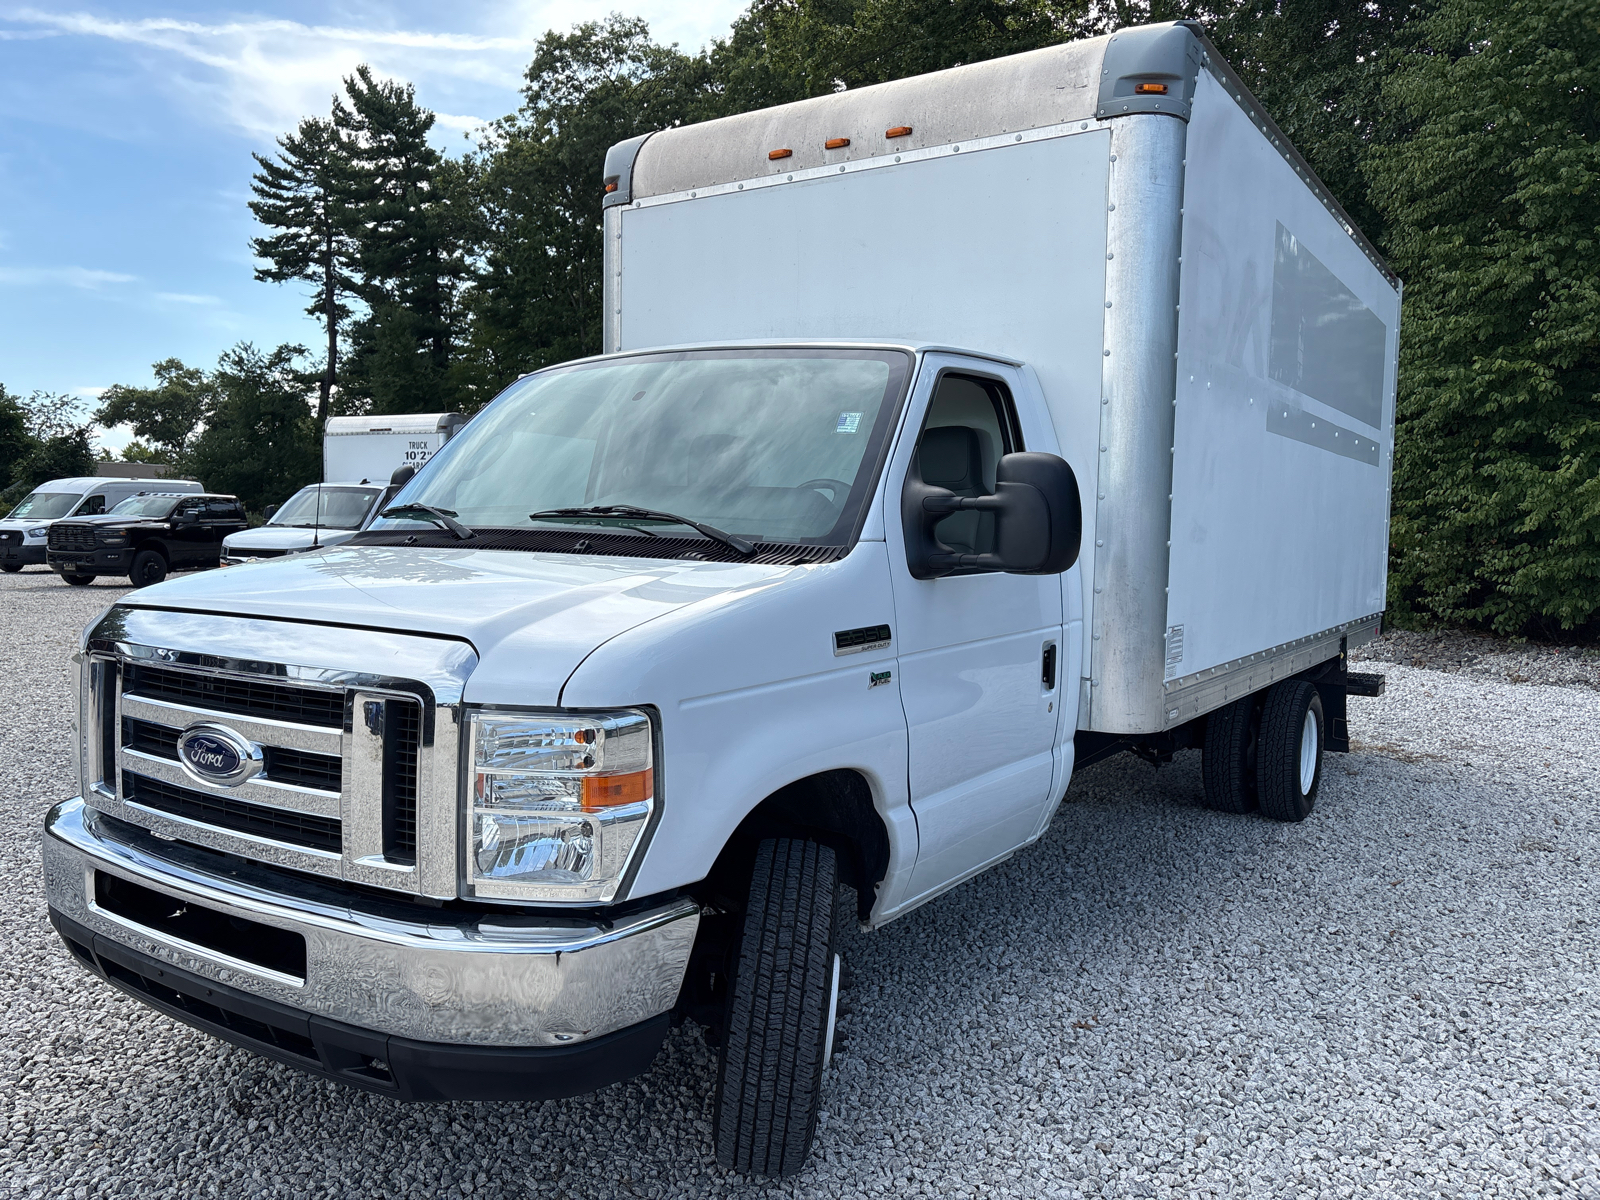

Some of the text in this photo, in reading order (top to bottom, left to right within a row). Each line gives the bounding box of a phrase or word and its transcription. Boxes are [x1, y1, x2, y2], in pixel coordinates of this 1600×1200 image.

[408, 441, 428, 450] TRUCK
[405, 450, 432, 460] 10'2"
[861, 641, 890, 651] SUPER DUTY
[190, 739, 226, 768] Ford
